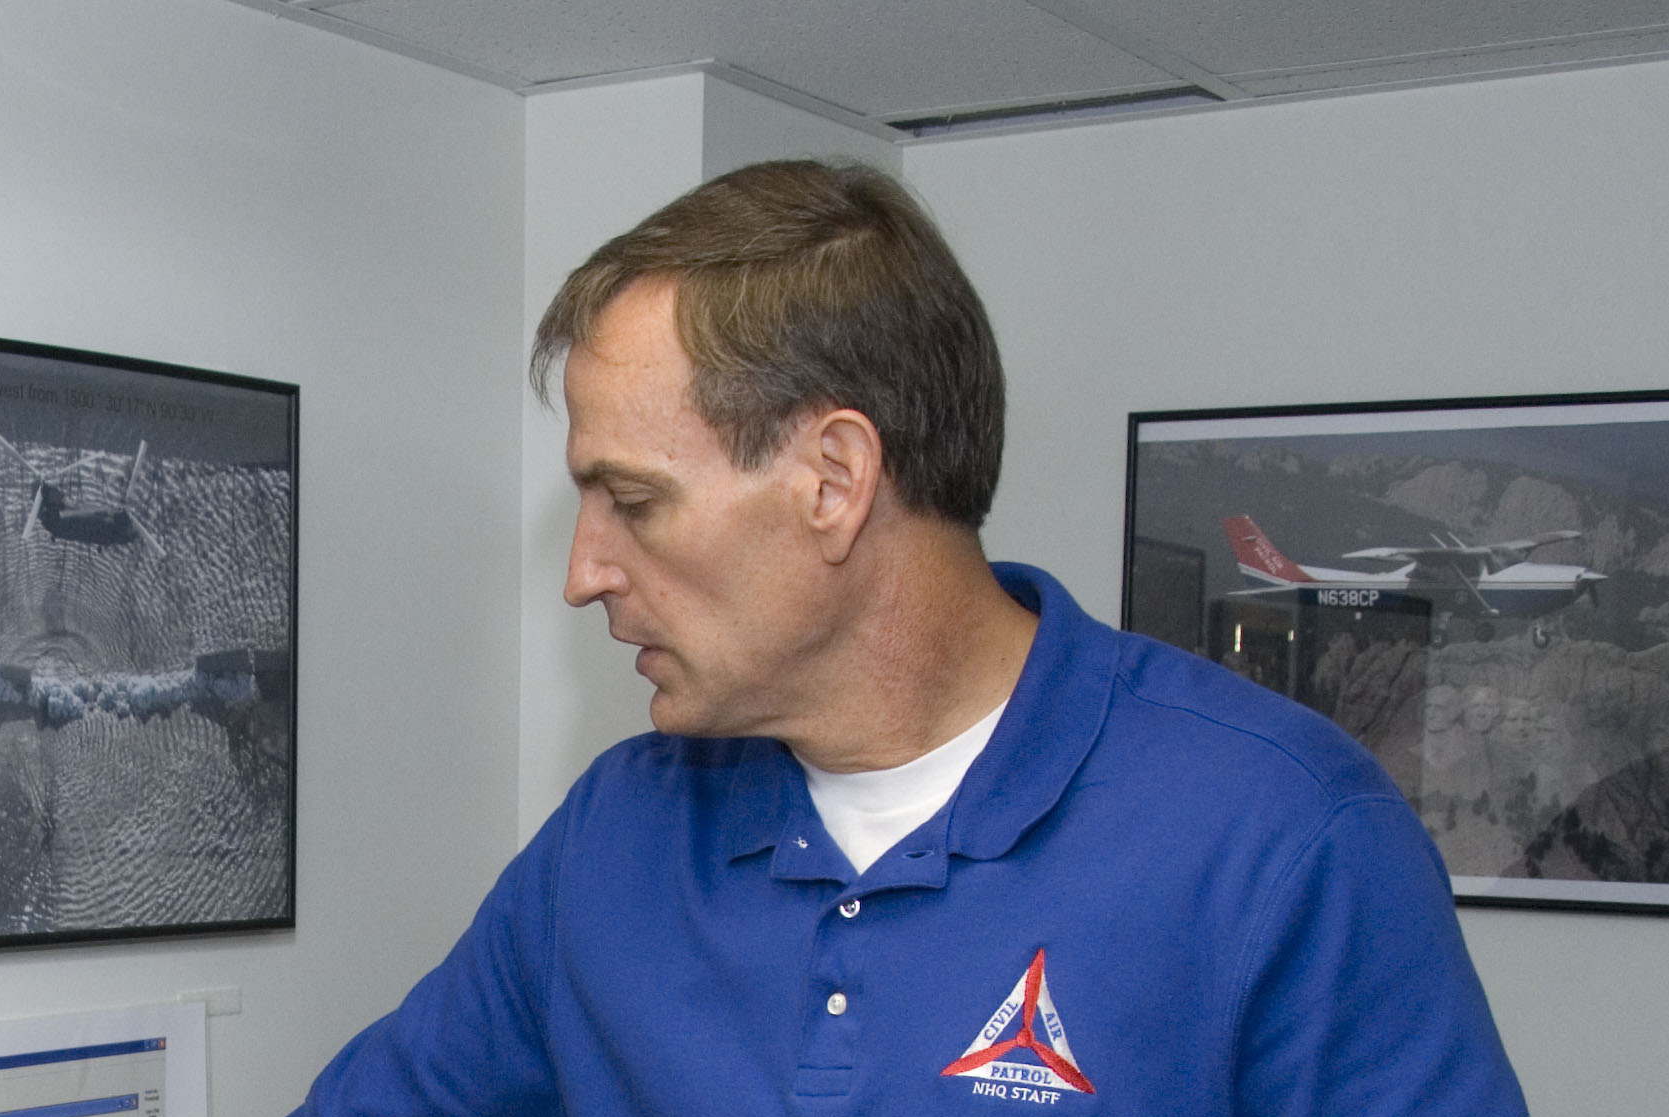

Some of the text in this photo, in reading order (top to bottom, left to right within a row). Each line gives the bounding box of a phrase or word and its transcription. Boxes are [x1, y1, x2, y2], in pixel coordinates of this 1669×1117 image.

[1317, 589, 1380, 607] N638CP
[983, 1000, 1018, 1041] CIVIL
[1044, 1011, 1062, 1042] AIR
[990, 1065, 1053, 1085] PATROL
[972, 1081, 1061, 1105] NHQ STAFF
